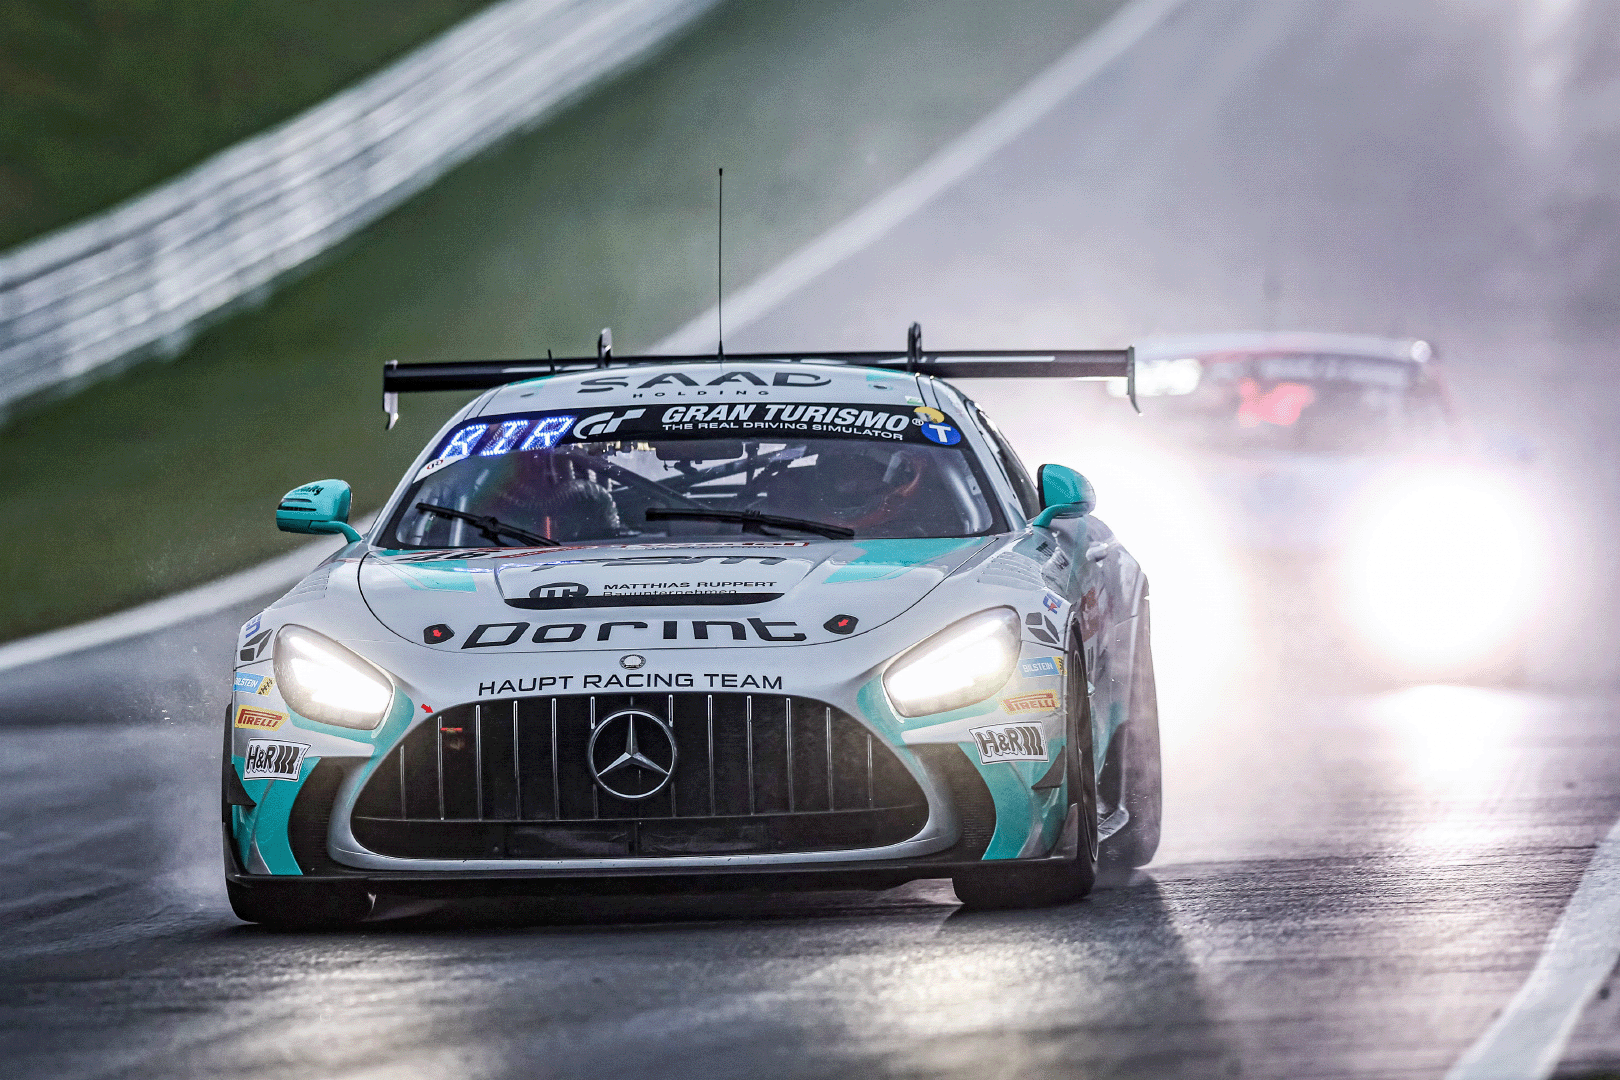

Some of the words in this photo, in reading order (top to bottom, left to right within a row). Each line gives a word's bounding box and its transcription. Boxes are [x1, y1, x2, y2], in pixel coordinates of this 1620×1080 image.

[576, 371, 832, 394] SAAD
[632, 390, 770, 398] HOLDING
[661, 404, 756, 424] GRAN
[698, 422, 739, 430] REAL
[744, 421, 808, 431] DRIVING
[811, 423, 904, 441] SIMULATOR
[603, 582, 691, 590] MATTHIAS
[1022, 662, 1054, 673] BILSTEIN
[478, 675, 574, 696] HAUPT
[582, 673, 695, 689] RACING
[703, 673, 784, 690] TEAM
[1003, 692, 1056, 712] PIRELLI
[237, 708, 282, 728] PIRELLI
